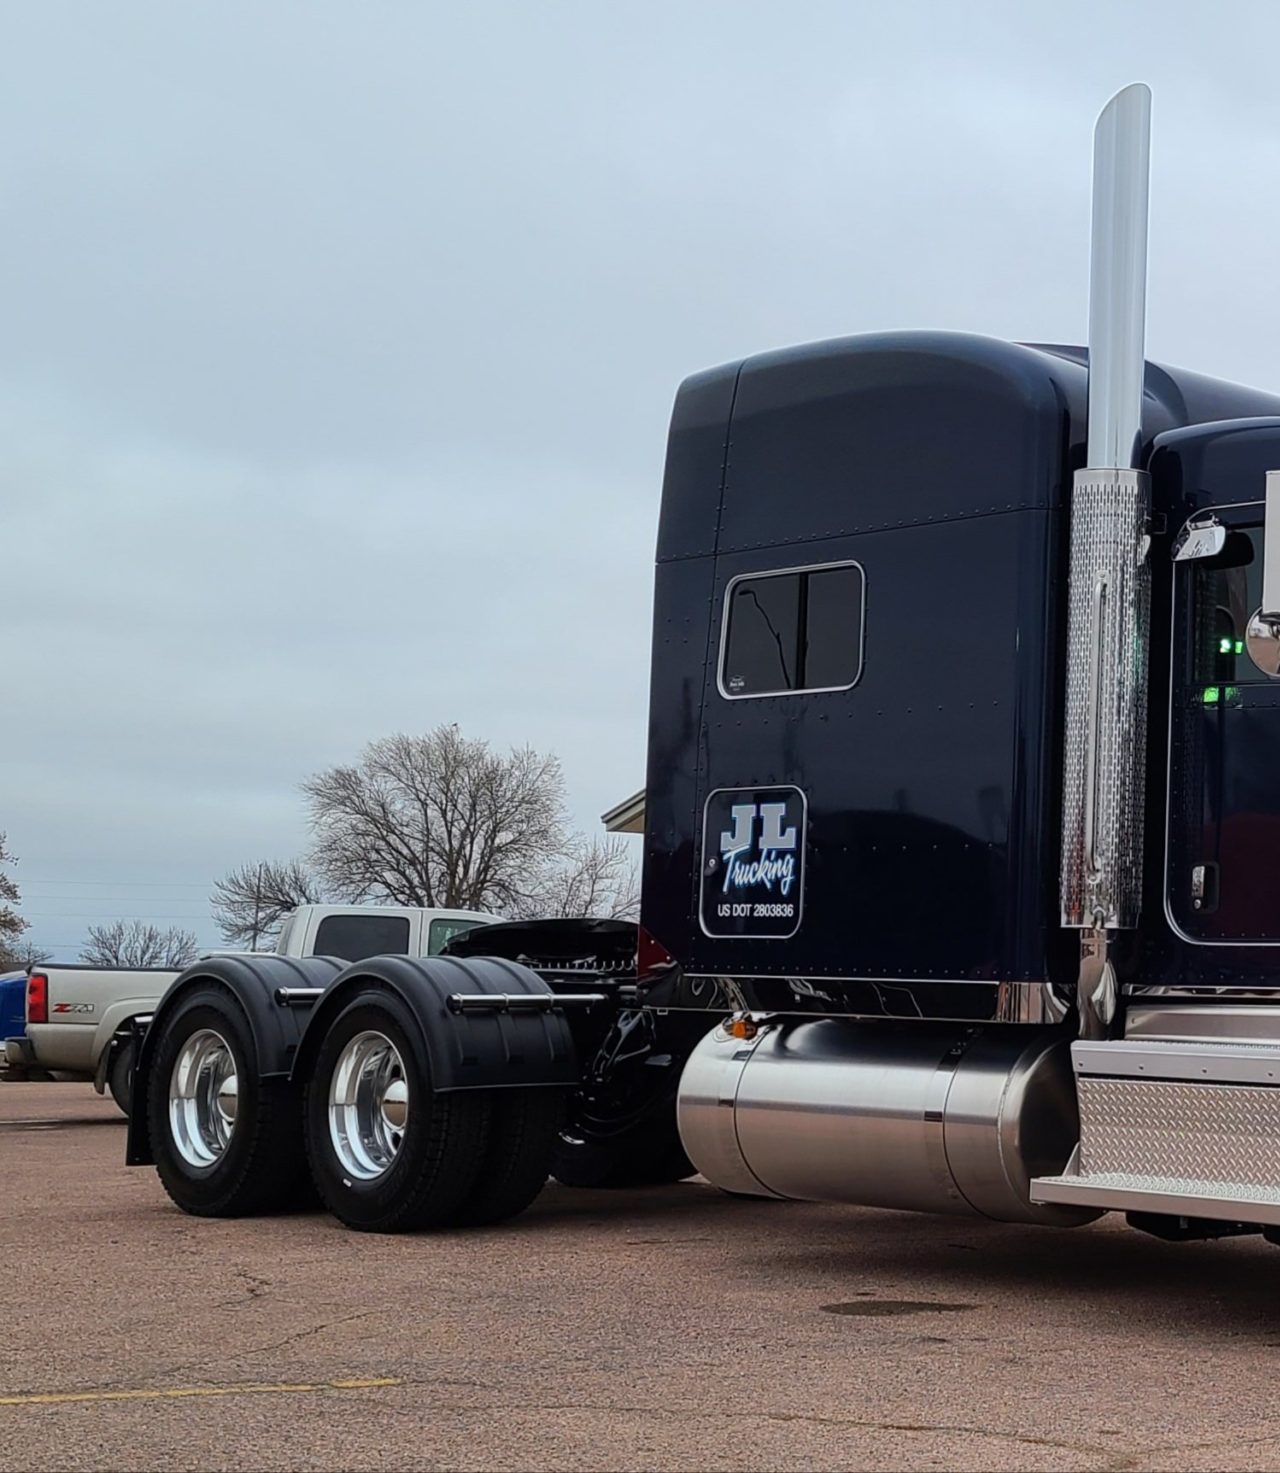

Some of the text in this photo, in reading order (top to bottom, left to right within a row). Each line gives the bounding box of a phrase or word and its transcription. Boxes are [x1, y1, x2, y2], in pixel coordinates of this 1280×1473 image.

[720, 803, 797, 852] JL
[722, 845, 795, 895] Trucking
[717, 903, 794, 917] US DOT 2803836
[51, 1003, 95, 1014] Z71
